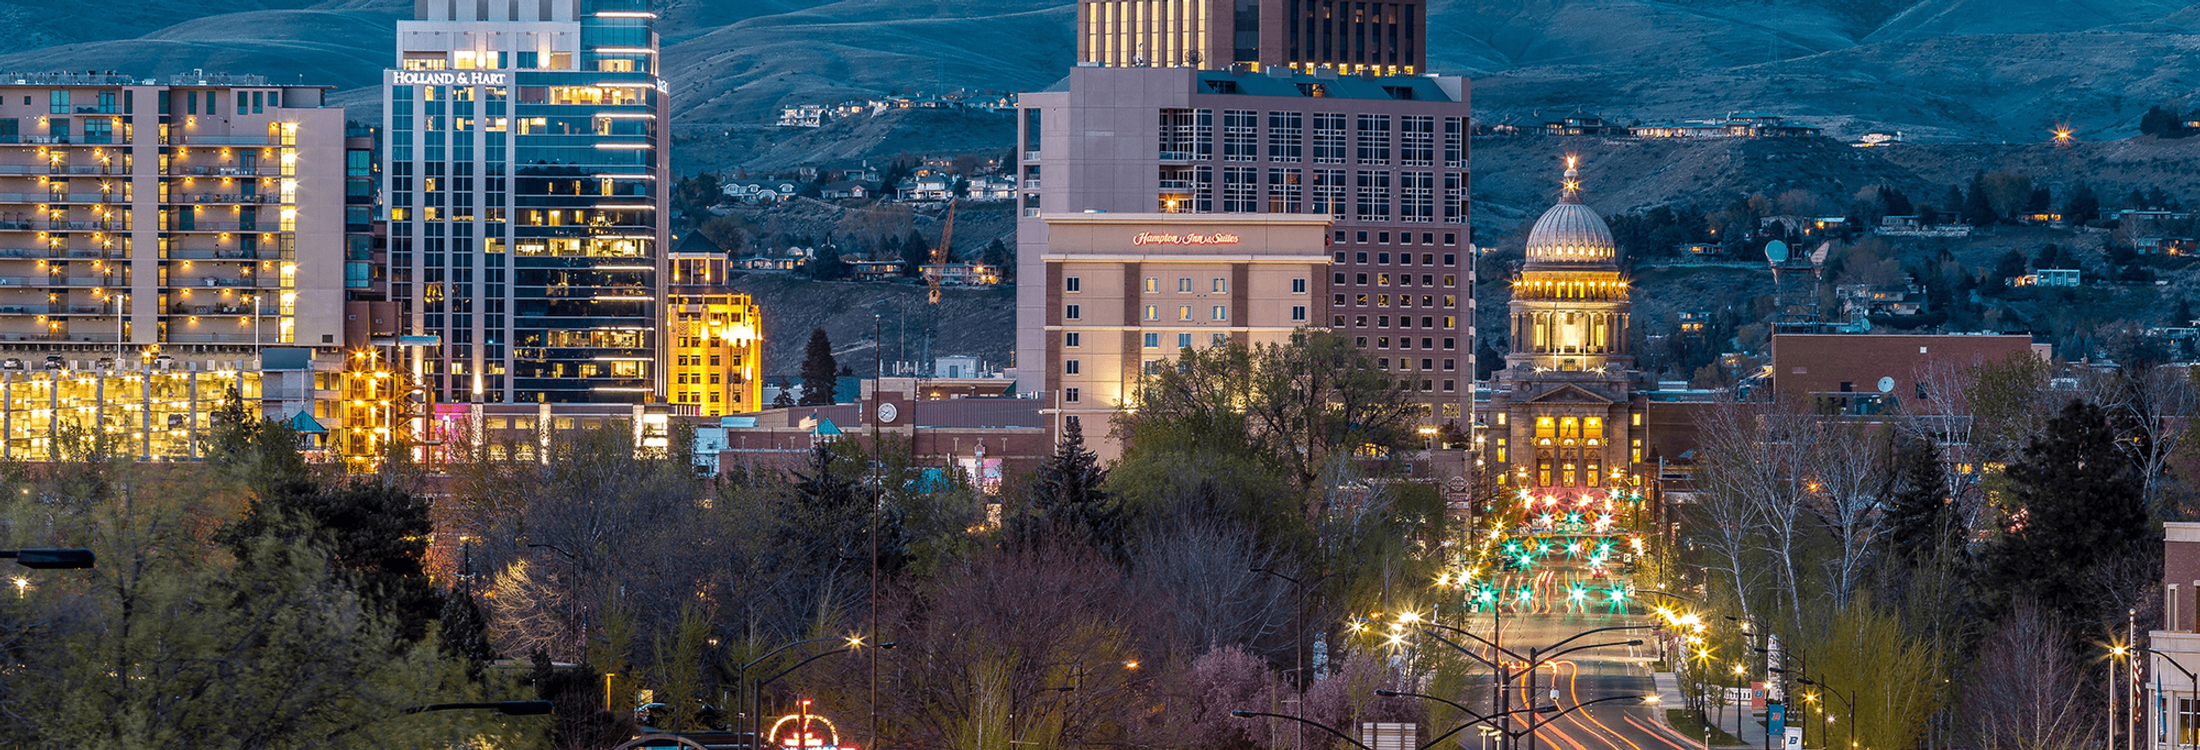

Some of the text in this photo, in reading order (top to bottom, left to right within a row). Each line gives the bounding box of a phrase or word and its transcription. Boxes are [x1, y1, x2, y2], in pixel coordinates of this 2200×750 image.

[393, 72, 506, 84] HOLLAND & HART
[1132, 231, 1182, 245] Hampton
[1182, 232, 1208, 245] Inn
[1212, 232, 1239, 244] Suites
[1788, 736, 1798, 744] B
